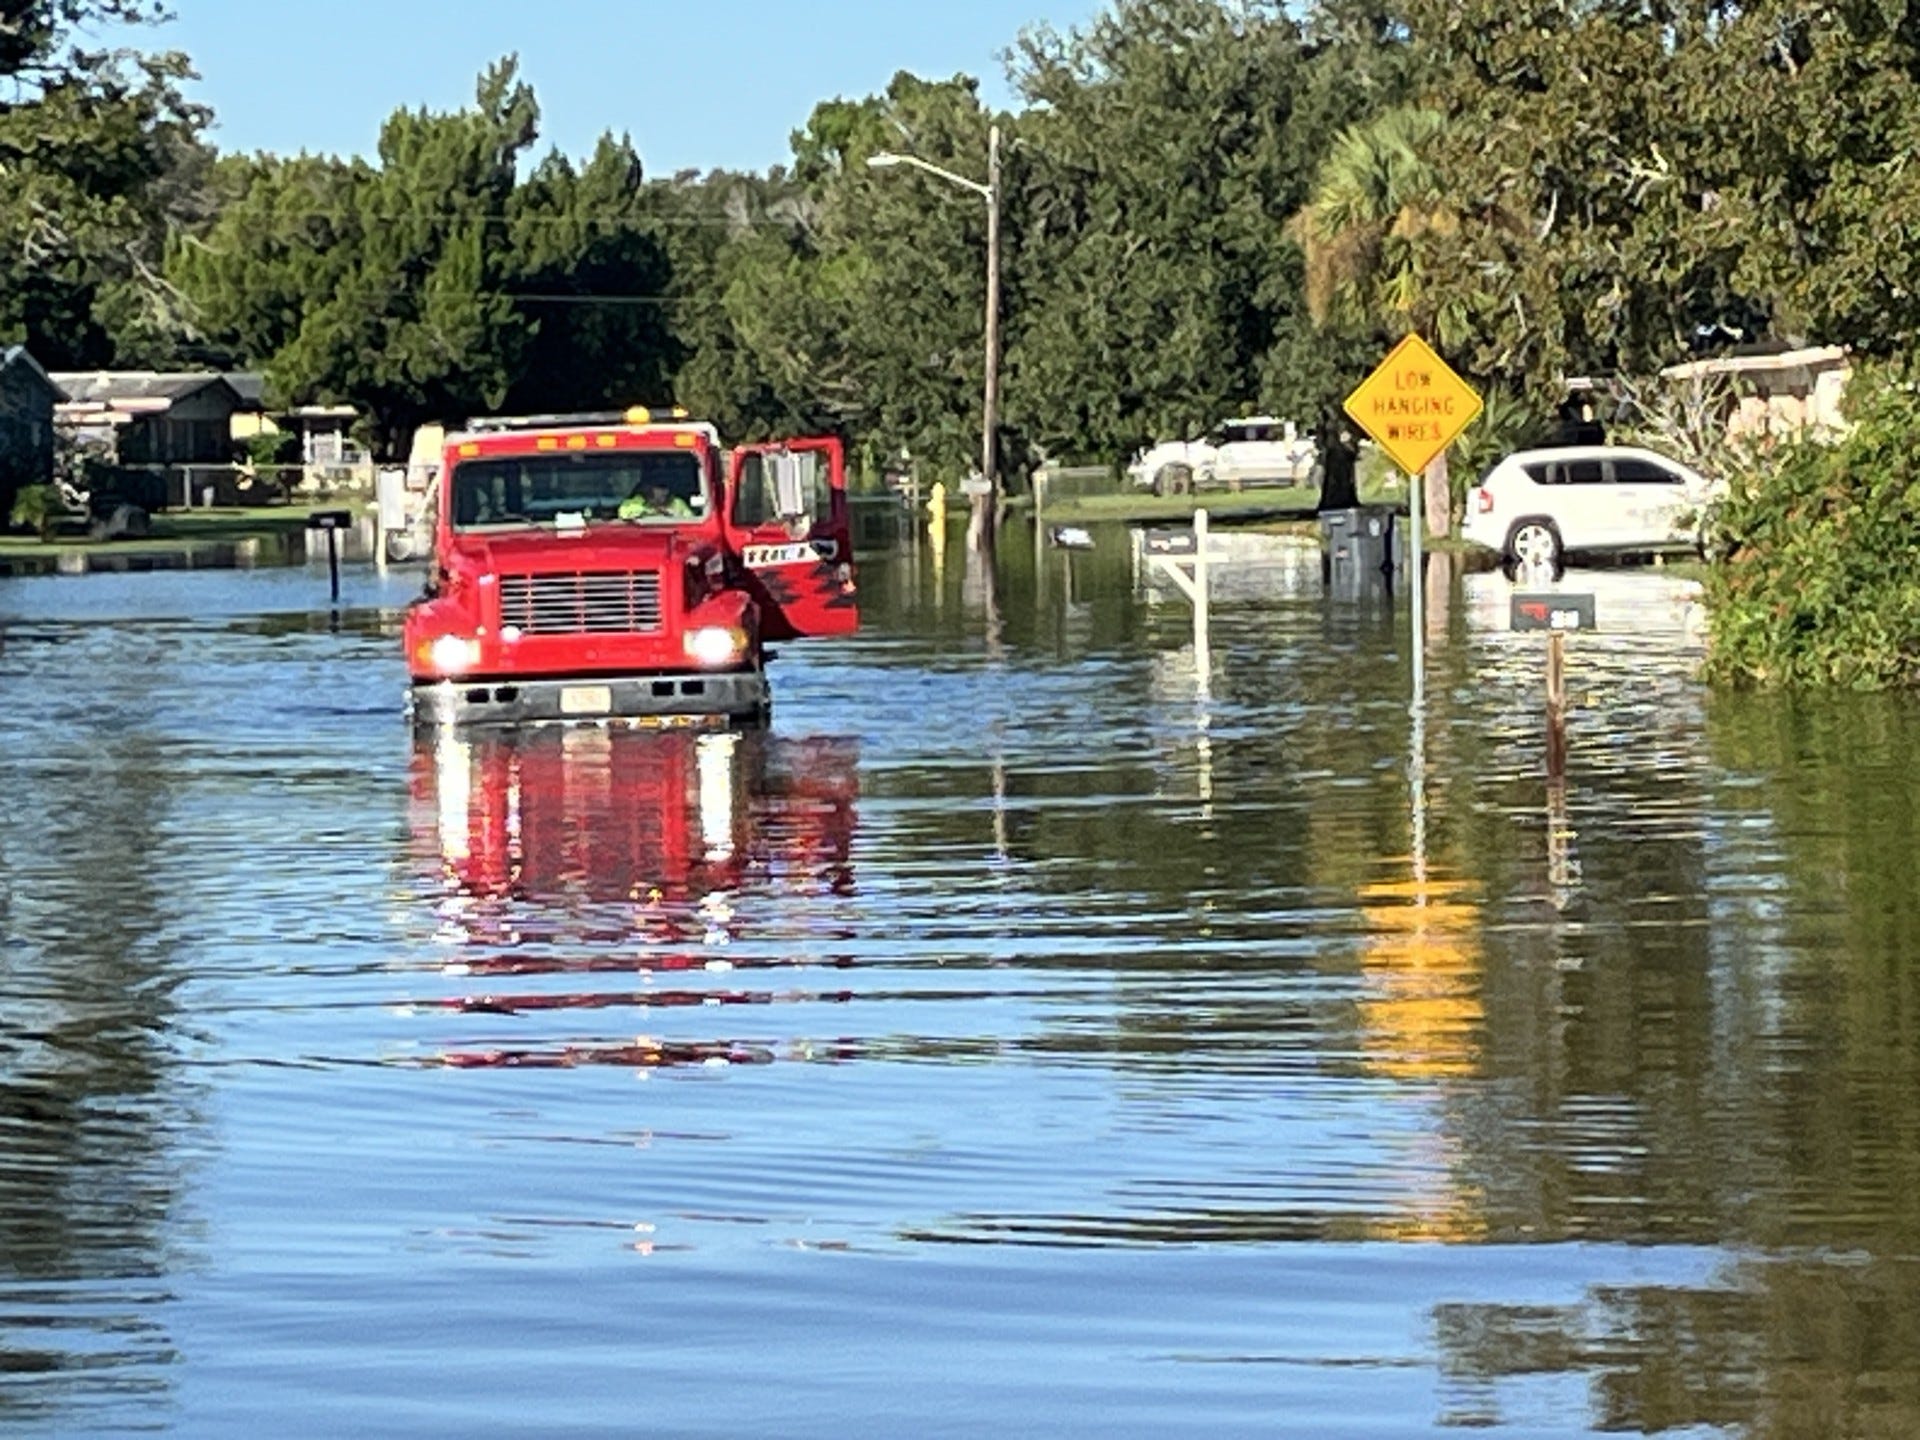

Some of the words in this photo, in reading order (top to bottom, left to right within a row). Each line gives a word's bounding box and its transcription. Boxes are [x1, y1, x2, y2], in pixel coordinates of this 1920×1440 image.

[1395, 370, 1432, 391] LOW
[1373, 395, 1455, 416] HANGING
[1387, 421, 1443, 441] WIRES
